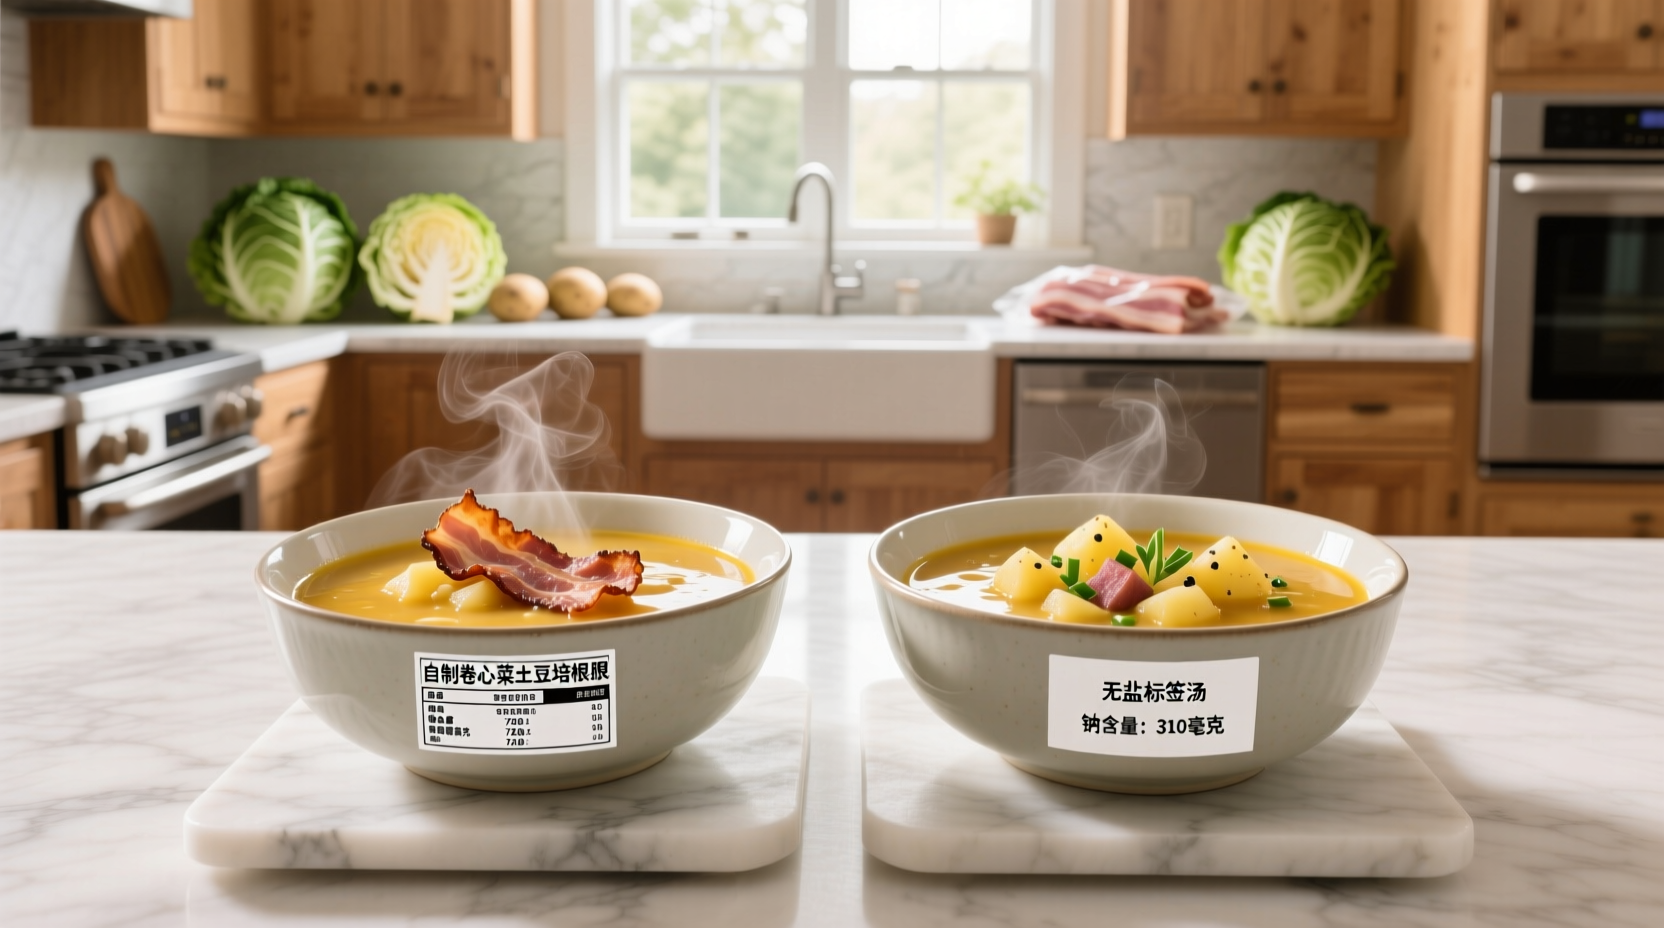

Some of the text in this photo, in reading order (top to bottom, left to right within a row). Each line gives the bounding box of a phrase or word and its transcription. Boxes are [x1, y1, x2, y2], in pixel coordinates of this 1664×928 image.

[1102, 680, 1206, 703] 无盐标签汤
